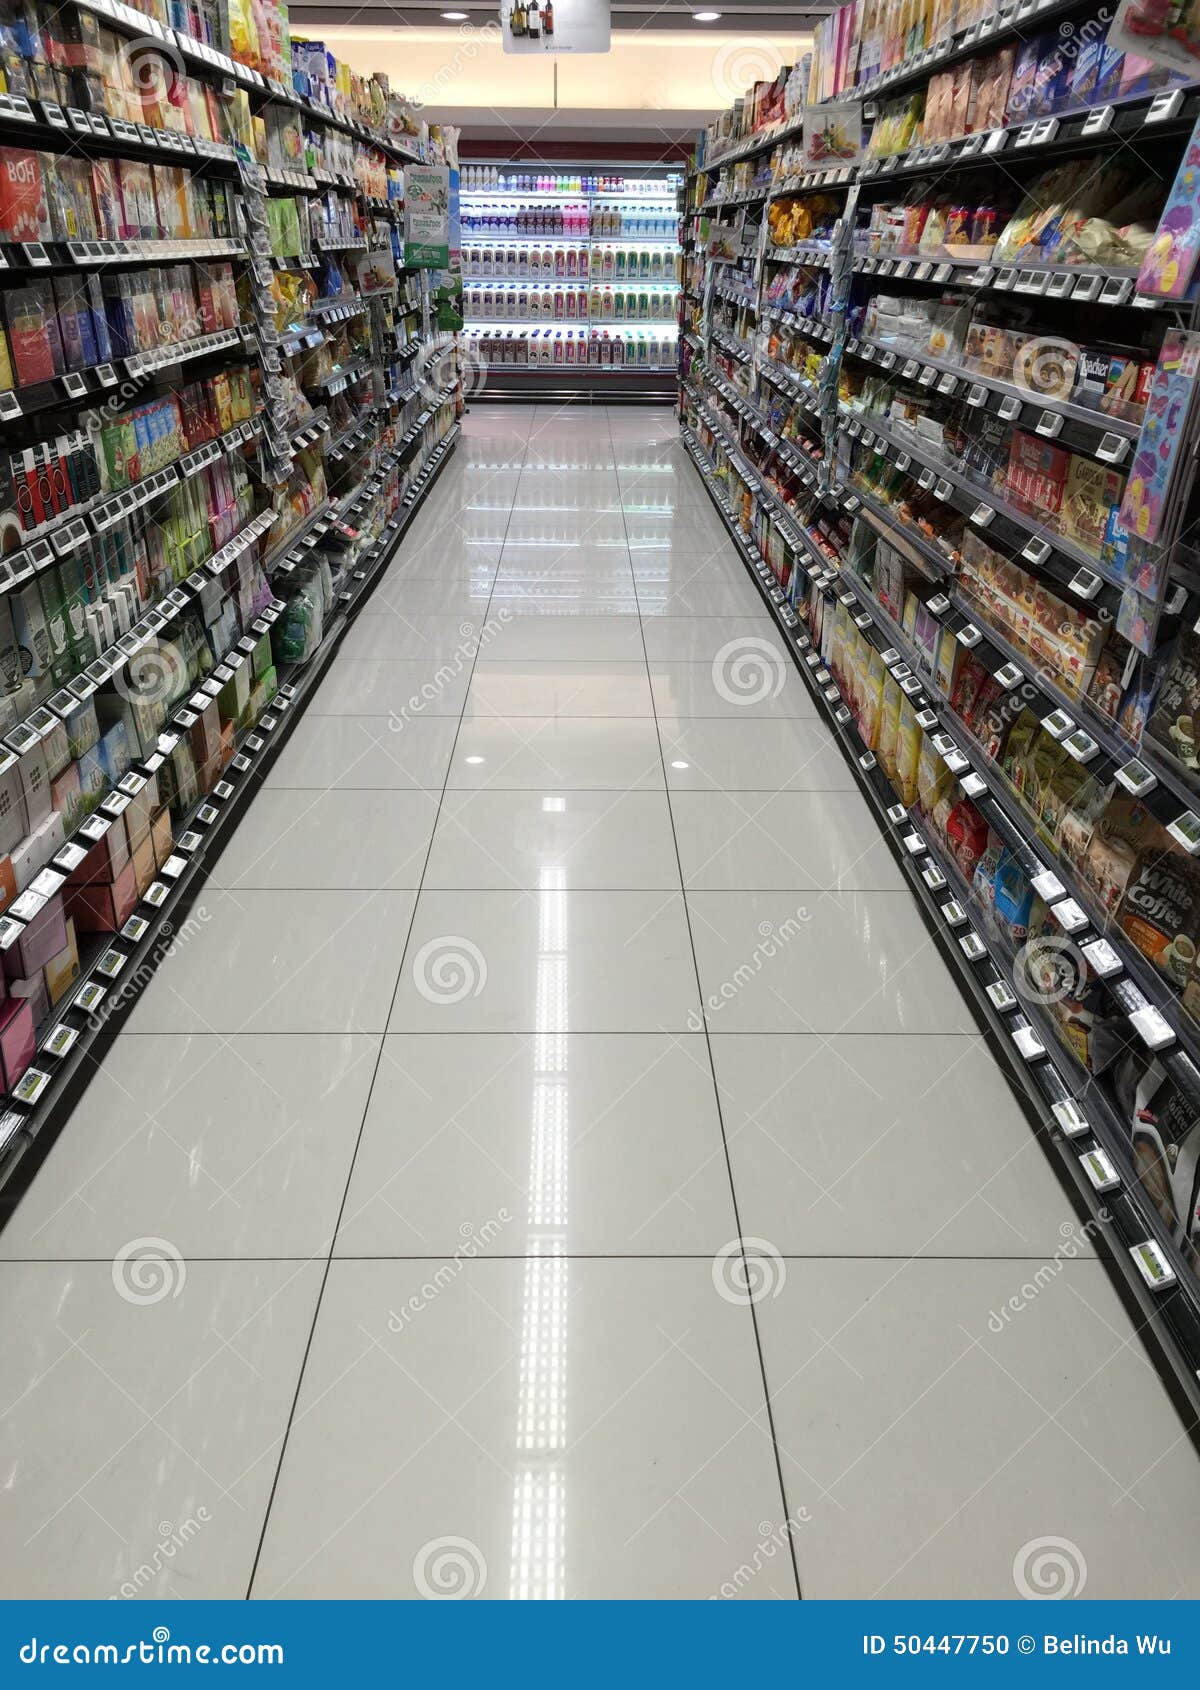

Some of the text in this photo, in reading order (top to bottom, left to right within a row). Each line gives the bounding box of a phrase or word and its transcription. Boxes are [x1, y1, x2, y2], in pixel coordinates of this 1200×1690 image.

[8, 161, 36, 183] BOH
[1139, 864, 1193, 911] White
[1127, 885, 1184, 929] Coffee
[1013, 925, 1026, 937] 20
